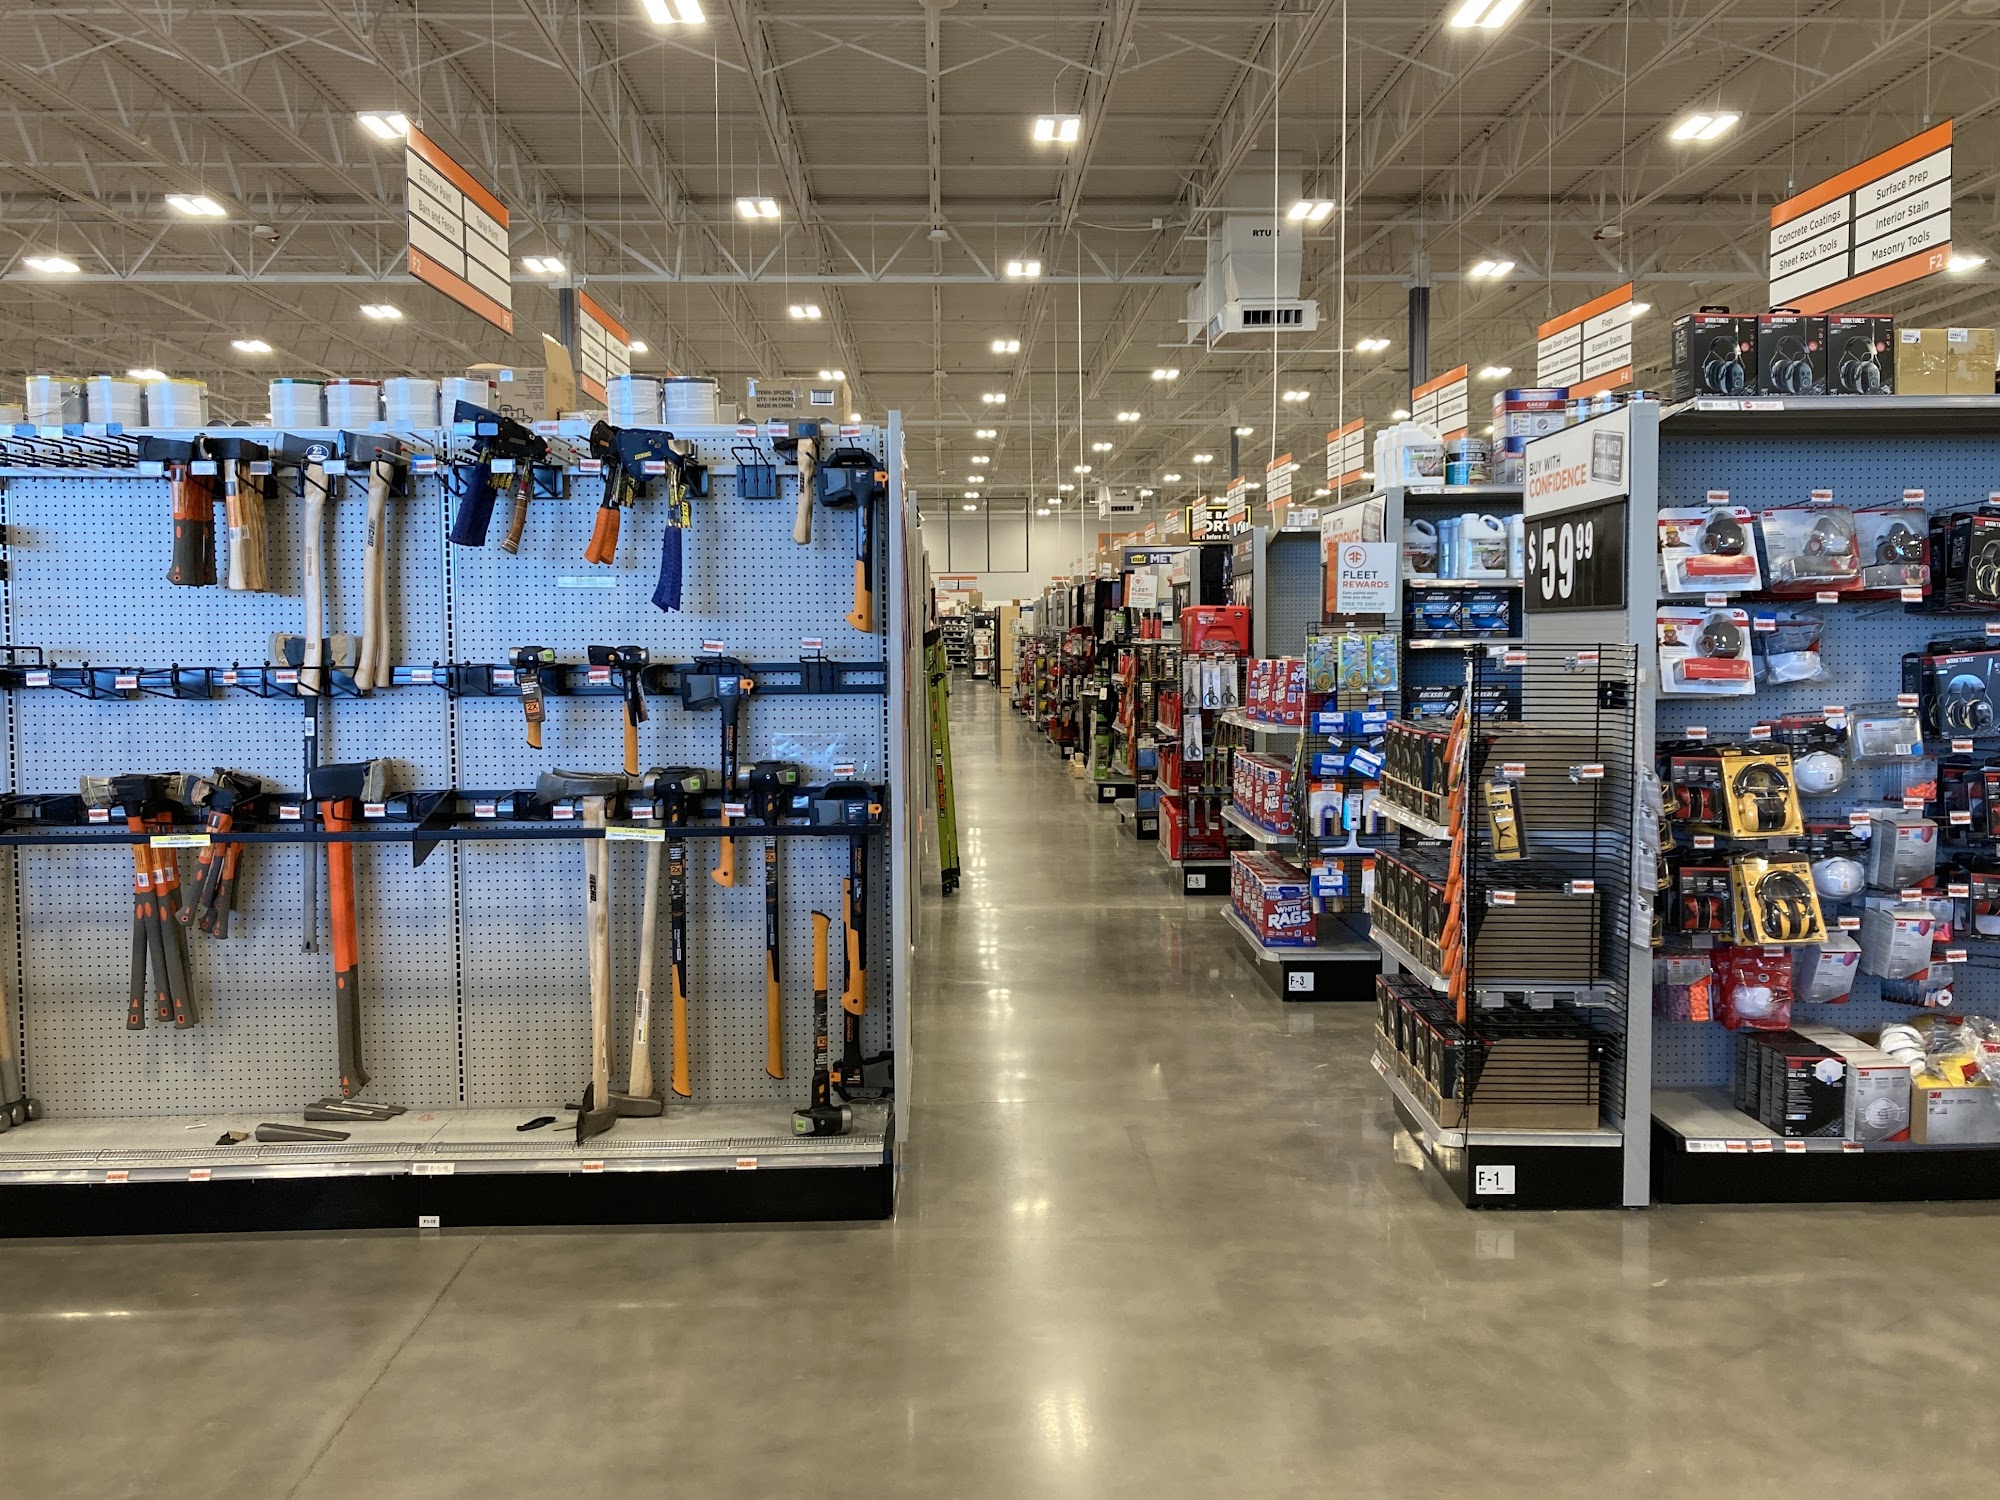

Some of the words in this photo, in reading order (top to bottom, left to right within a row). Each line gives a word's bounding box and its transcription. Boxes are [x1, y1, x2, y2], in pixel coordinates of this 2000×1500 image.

[1876, 178, 1906, 200] Surface
[1908, 169, 1928, 186] Prep
[419, 199, 430, 217] Barn
[431, 210, 440, 225] and
[442, 216, 455, 235] Fence
[1876, 209, 1906, 230] Interior
[1908, 199, 1929, 217] Stain
[1252, 229, 1272, 237] RTU
[1778, 224, 1808, 244] Concrete
[1809, 210, 1841, 230] Coatings
[1779, 255, 1798, 270] Sheet
[1800, 248, 1817, 262] Rock
[1818, 238, 1838, 254] Tools
[1872, 240, 1906, 262] Masonry
[1908, 230, 1930, 247] Tools
[412, 258, 421, 274] F2
[1930, 254, 1942, 270] F2
[1601, 318, 1614, 328] Flags
[1540, 343, 1552, 354] Garage
[1553, 340, 1562, 348] Door
[1592, 340, 1609, 352] Exterior
[1610, 334, 1622, 345] Stains
[1586, 363, 1600, 374] Exterior
[1600, 358, 1612, 368] Water
[1612, 352, 1628, 364] Proofing
[1554, 372, 1578, 386] Organization
[1530, 460, 1542, 476] BUY
[1544, 453, 1561, 471] WITH
[1529, 463, 1587, 498] CONFIDENCE
[1734, 508, 1747, 516] 3M
[1342, 570, 1378, 580] FLEET
[1188, 876, 1199, 884] F-5
[1274, 904, 1301, 914] WHITE
[1268, 910, 1312, 930] RAGS
[1290, 976, 1304, 986] F-3
[1479, 1172, 1498, 1186] F-1
